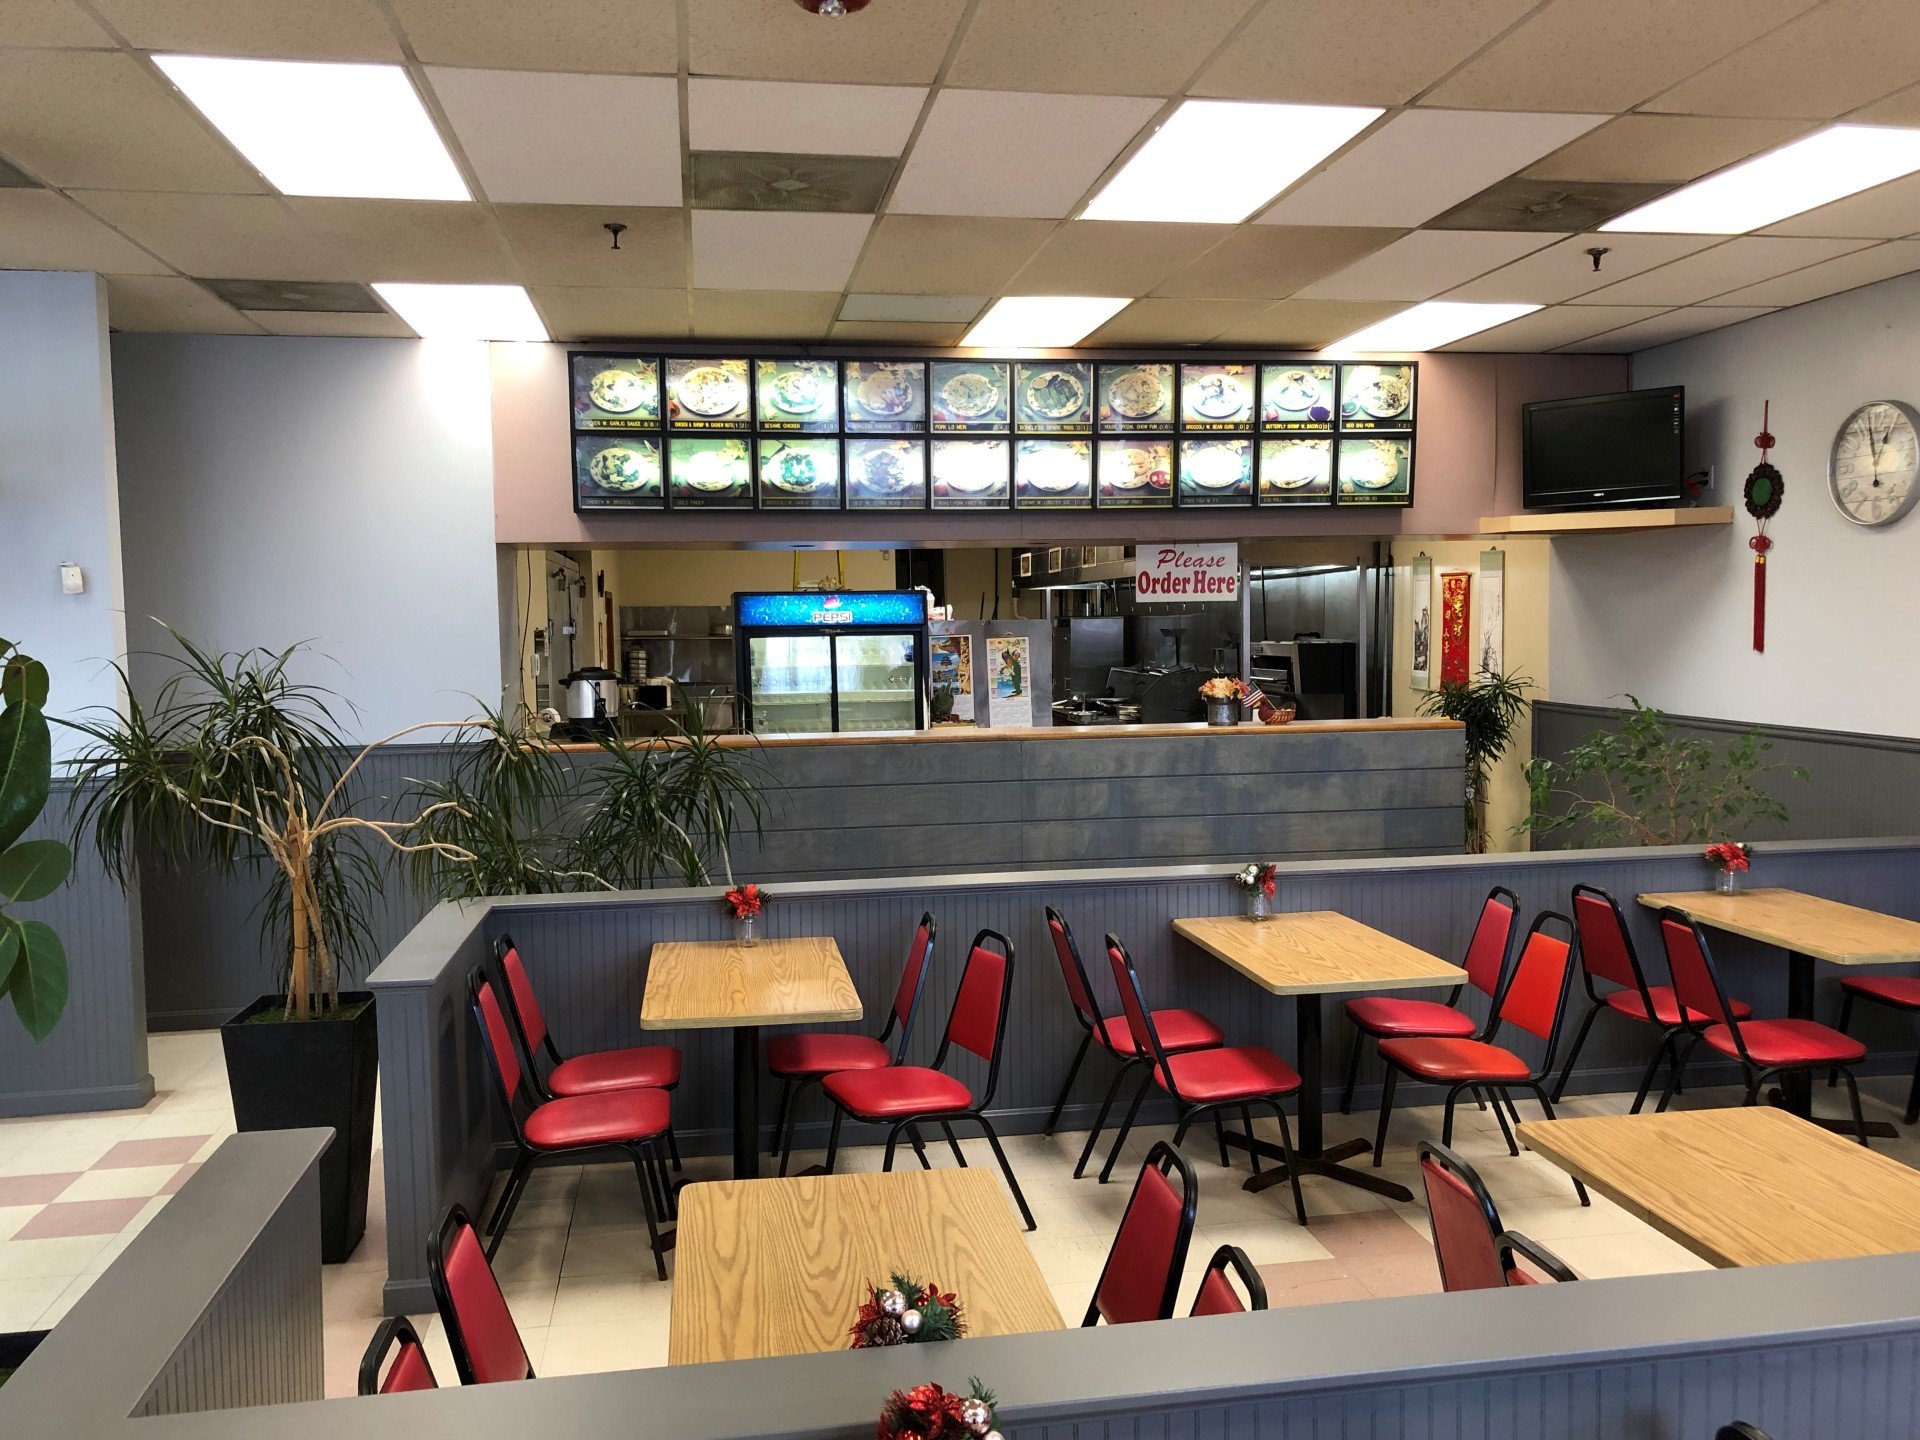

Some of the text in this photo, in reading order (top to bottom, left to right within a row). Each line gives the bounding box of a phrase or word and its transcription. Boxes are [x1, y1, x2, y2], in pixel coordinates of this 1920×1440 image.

[1157, 549, 1225, 569] Please
[1138, 570, 1235, 594] Order Here
[813, 612, 852, 622] PEPSI
